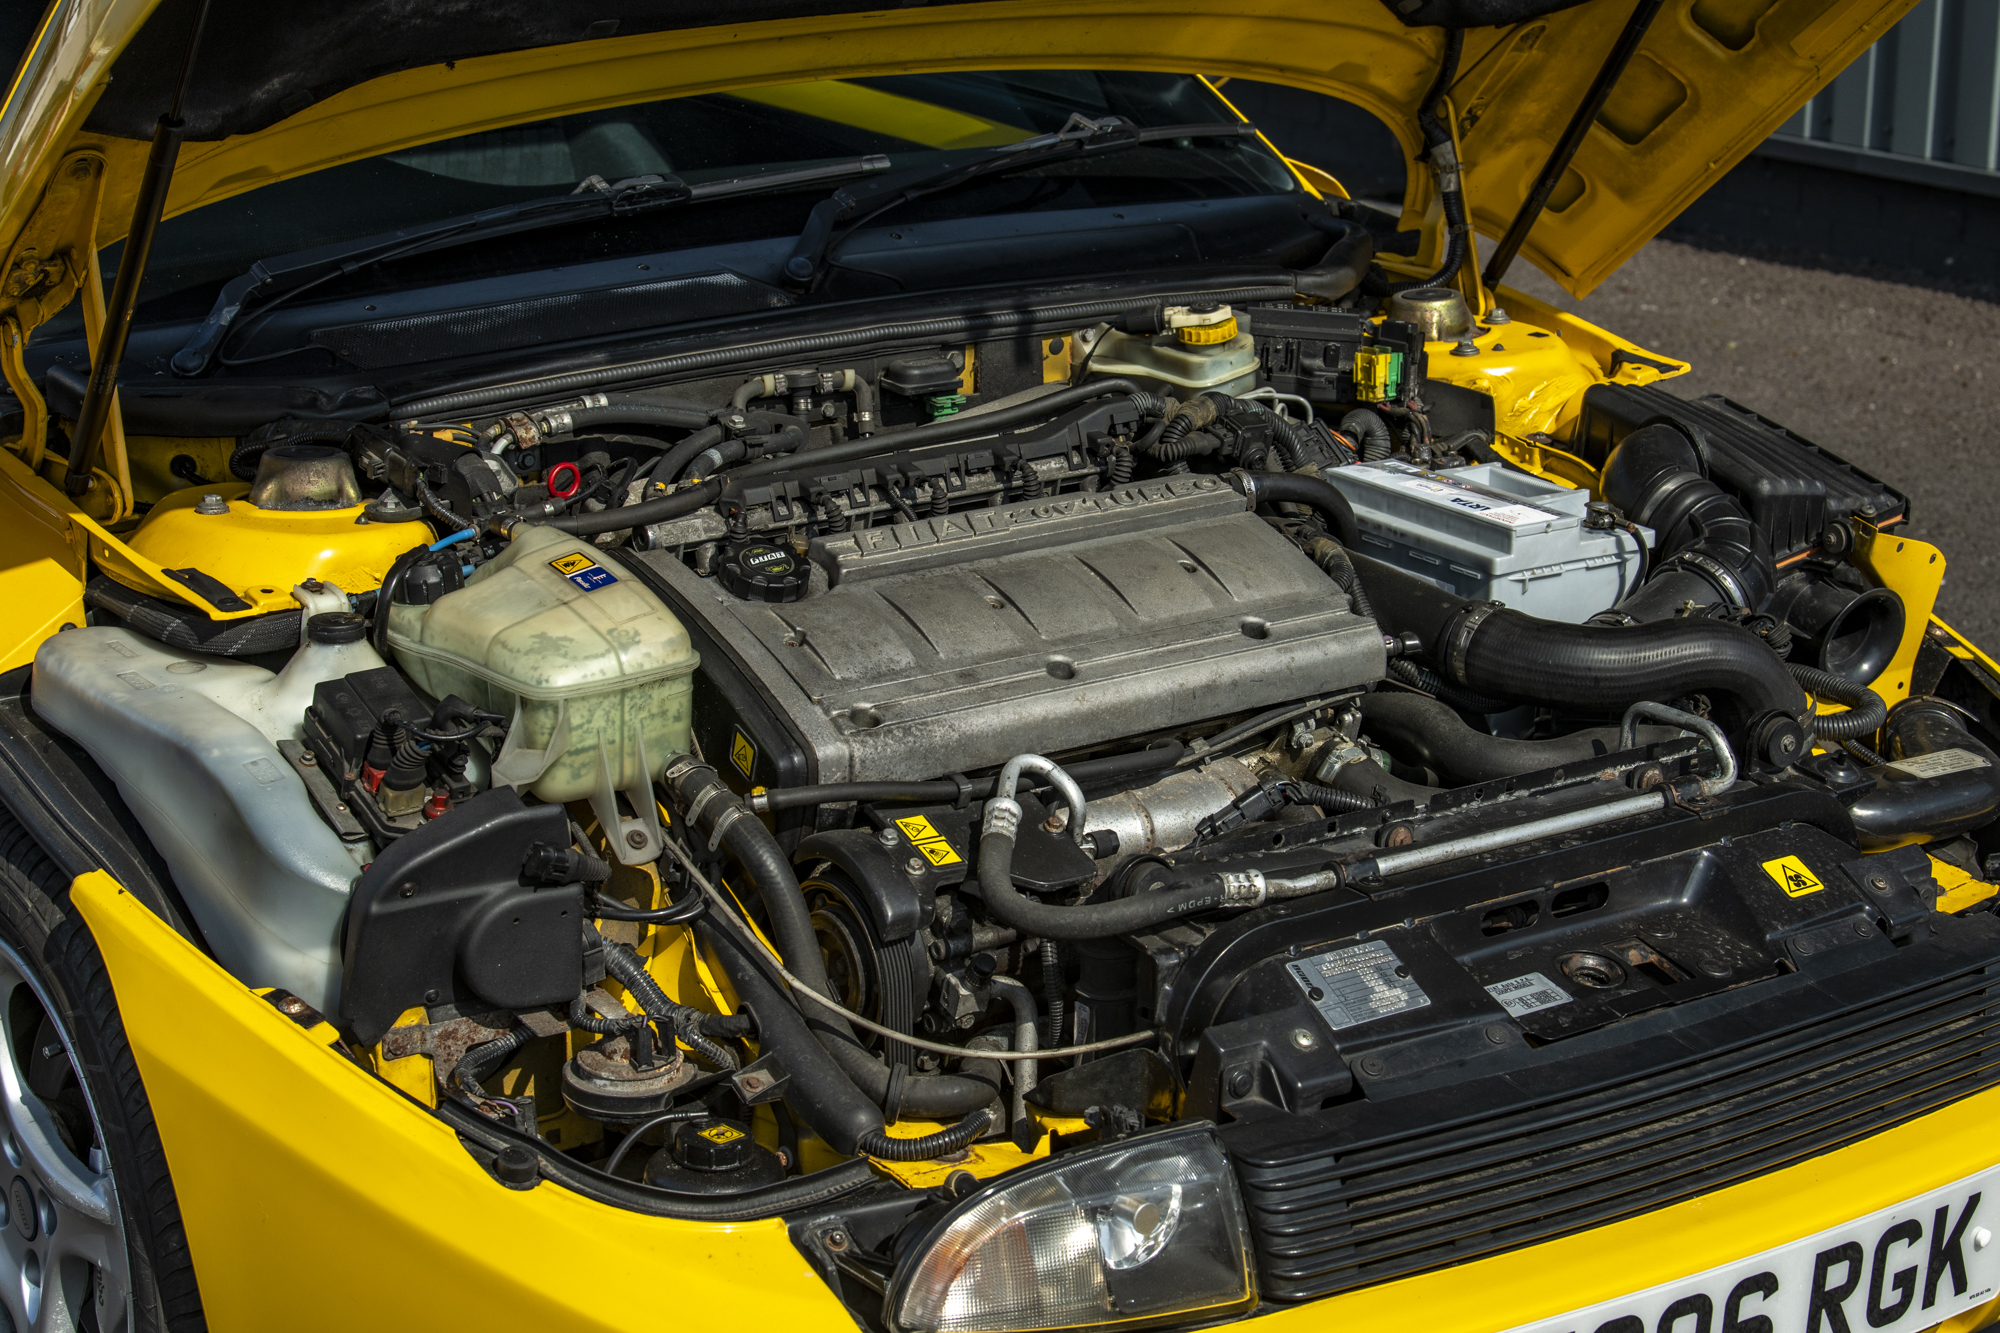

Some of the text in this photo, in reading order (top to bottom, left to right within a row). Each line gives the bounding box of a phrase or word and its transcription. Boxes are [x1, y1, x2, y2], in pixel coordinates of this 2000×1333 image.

[1451, 497, 1490, 512] ARTA
[865, 509, 997, 550] FIAT
[1806, 1190, 1982, 1333] RGK
